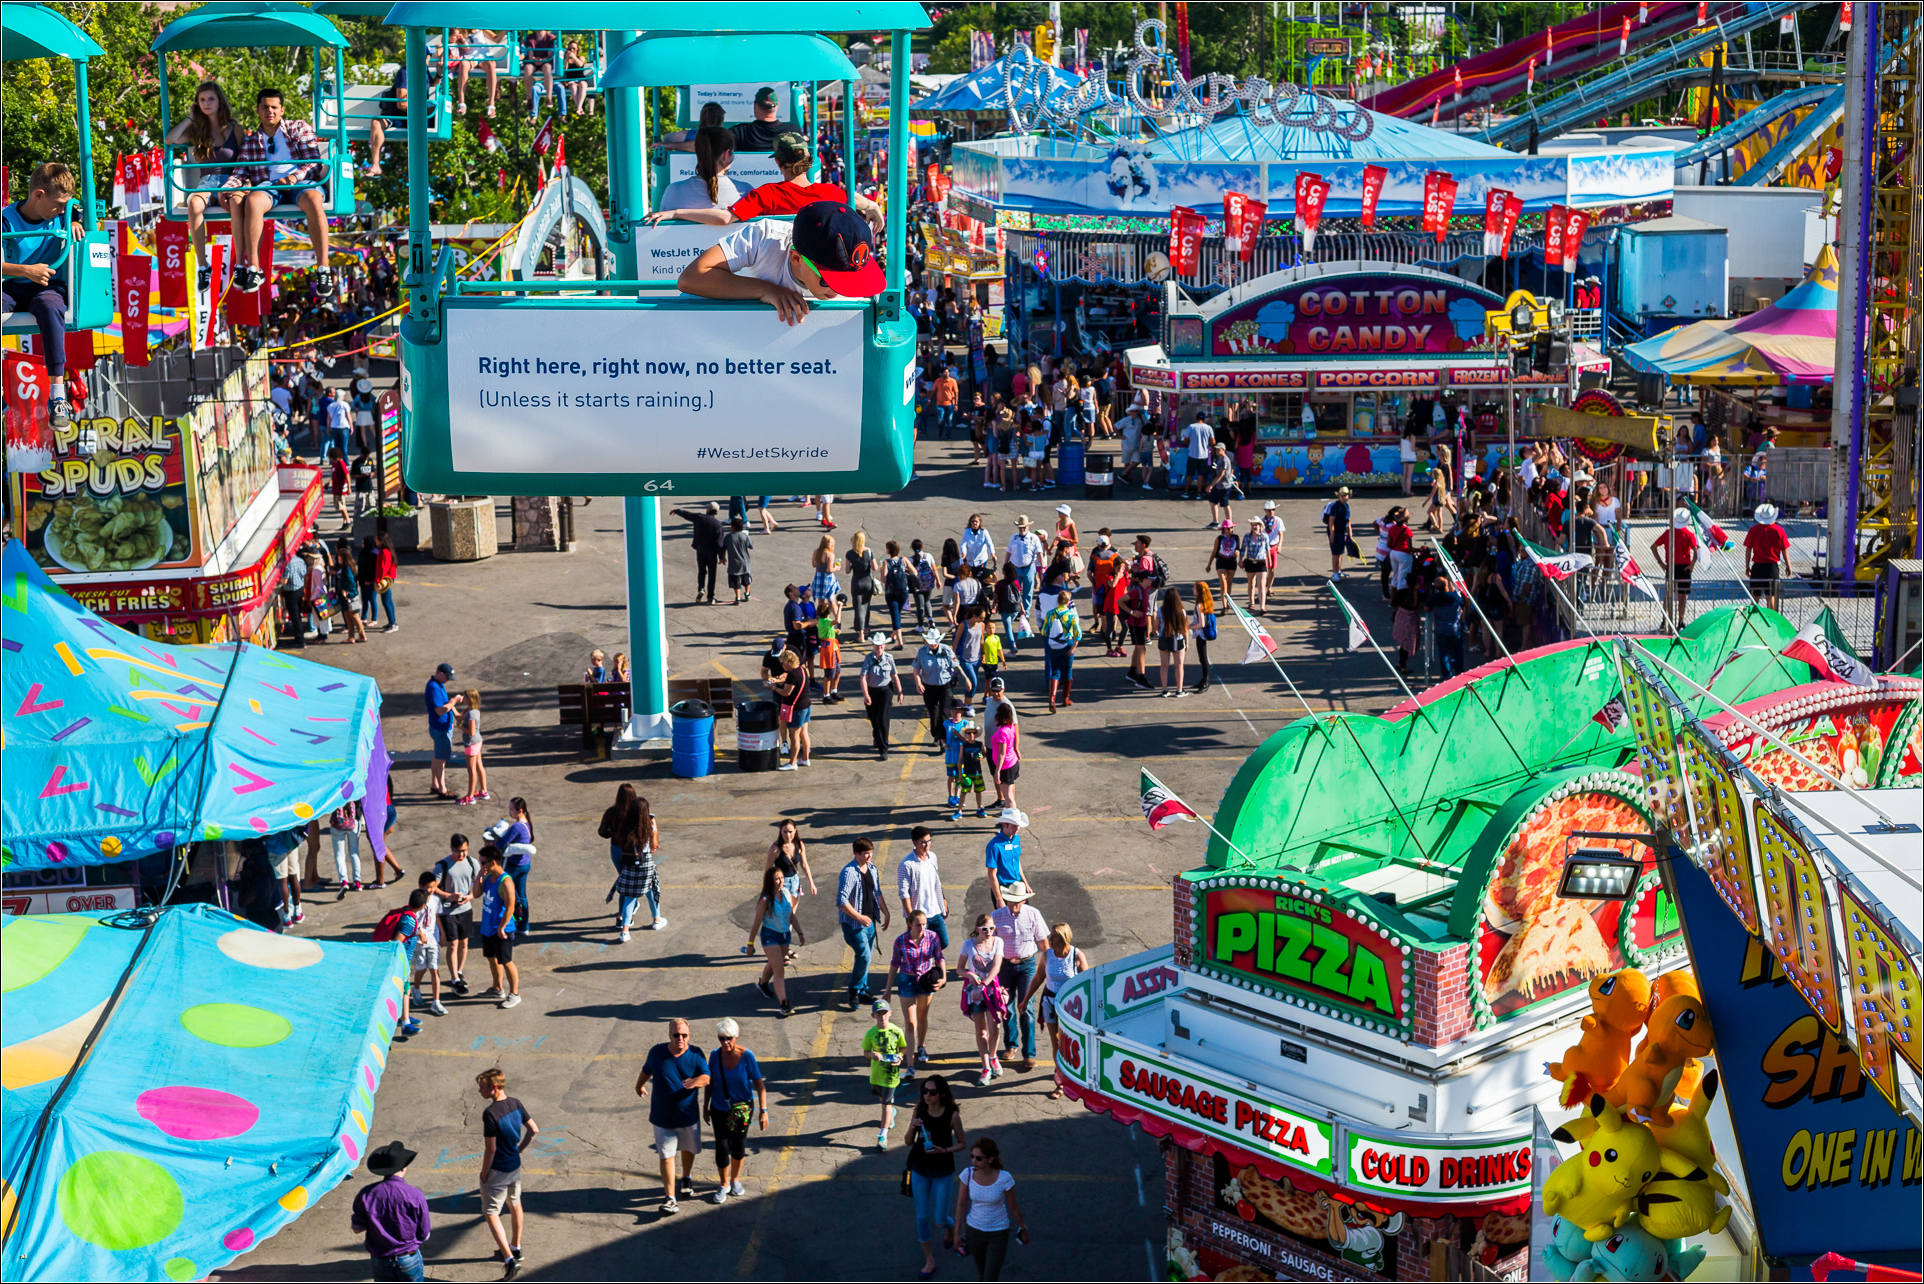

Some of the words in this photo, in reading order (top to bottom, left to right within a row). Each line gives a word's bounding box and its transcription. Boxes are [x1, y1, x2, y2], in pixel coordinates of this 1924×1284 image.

[651, 249, 690, 257] WestJet
[652, 266, 673, 274] Kind
[1300, 290, 1447, 316] COTTON
[1308, 325, 1432, 351] CANDY
[478, 356, 531, 378] Right
[536, 357, 587, 377] here,
[592, 357, 640, 379] right
[645, 361, 690, 378] now,
[696, 361, 720, 375] no
[725, 357, 786, 375] better
[790, 358, 837, 375] seat.
[1140, 369, 1169, 379] COLD
[1454, 369, 1499, 383] FROZEN
[1186, 373, 1230, 388] SNO
[1235, 372, 1304, 387] KONES
[1320, 371, 1436, 386] POPCORN
[479, 389, 551, 408] (Unless
[557, 391, 569, 408] it
[575, 392, 630, 408] starts
[636, 389, 714, 412] raining.)
[696, 447, 829, 461] #WestJetSkyride
[40, 454, 166, 496] SPUDS
[643, 479, 675, 492] 64
[209, 576, 253, 595] SPIRAL
[117, 595, 170, 611] FRIES
[212, 589, 254, 606] SPUDS
[66, 893, 116, 912] OVER
[1275, 895, 1333, 925] RICK'S
[1216, 911, 1396, 1016] PIZZA
[1119, 1059, 1228, 1125] SAUSAGE
[1234, 1099, 1310, 1155] PIZZA
[1361, 1147, 1430, 1188] COLD
[1439, 1146, 1532, 1189] DRINKS
[1782, 1128, 1856, 1190] ONE
[1858, 1128, 1897, 1184] IN
[1211, 1222, 1272, 1258] PEPPERONI
[1280, 1251, 1334, 1282] SAUSAGE
